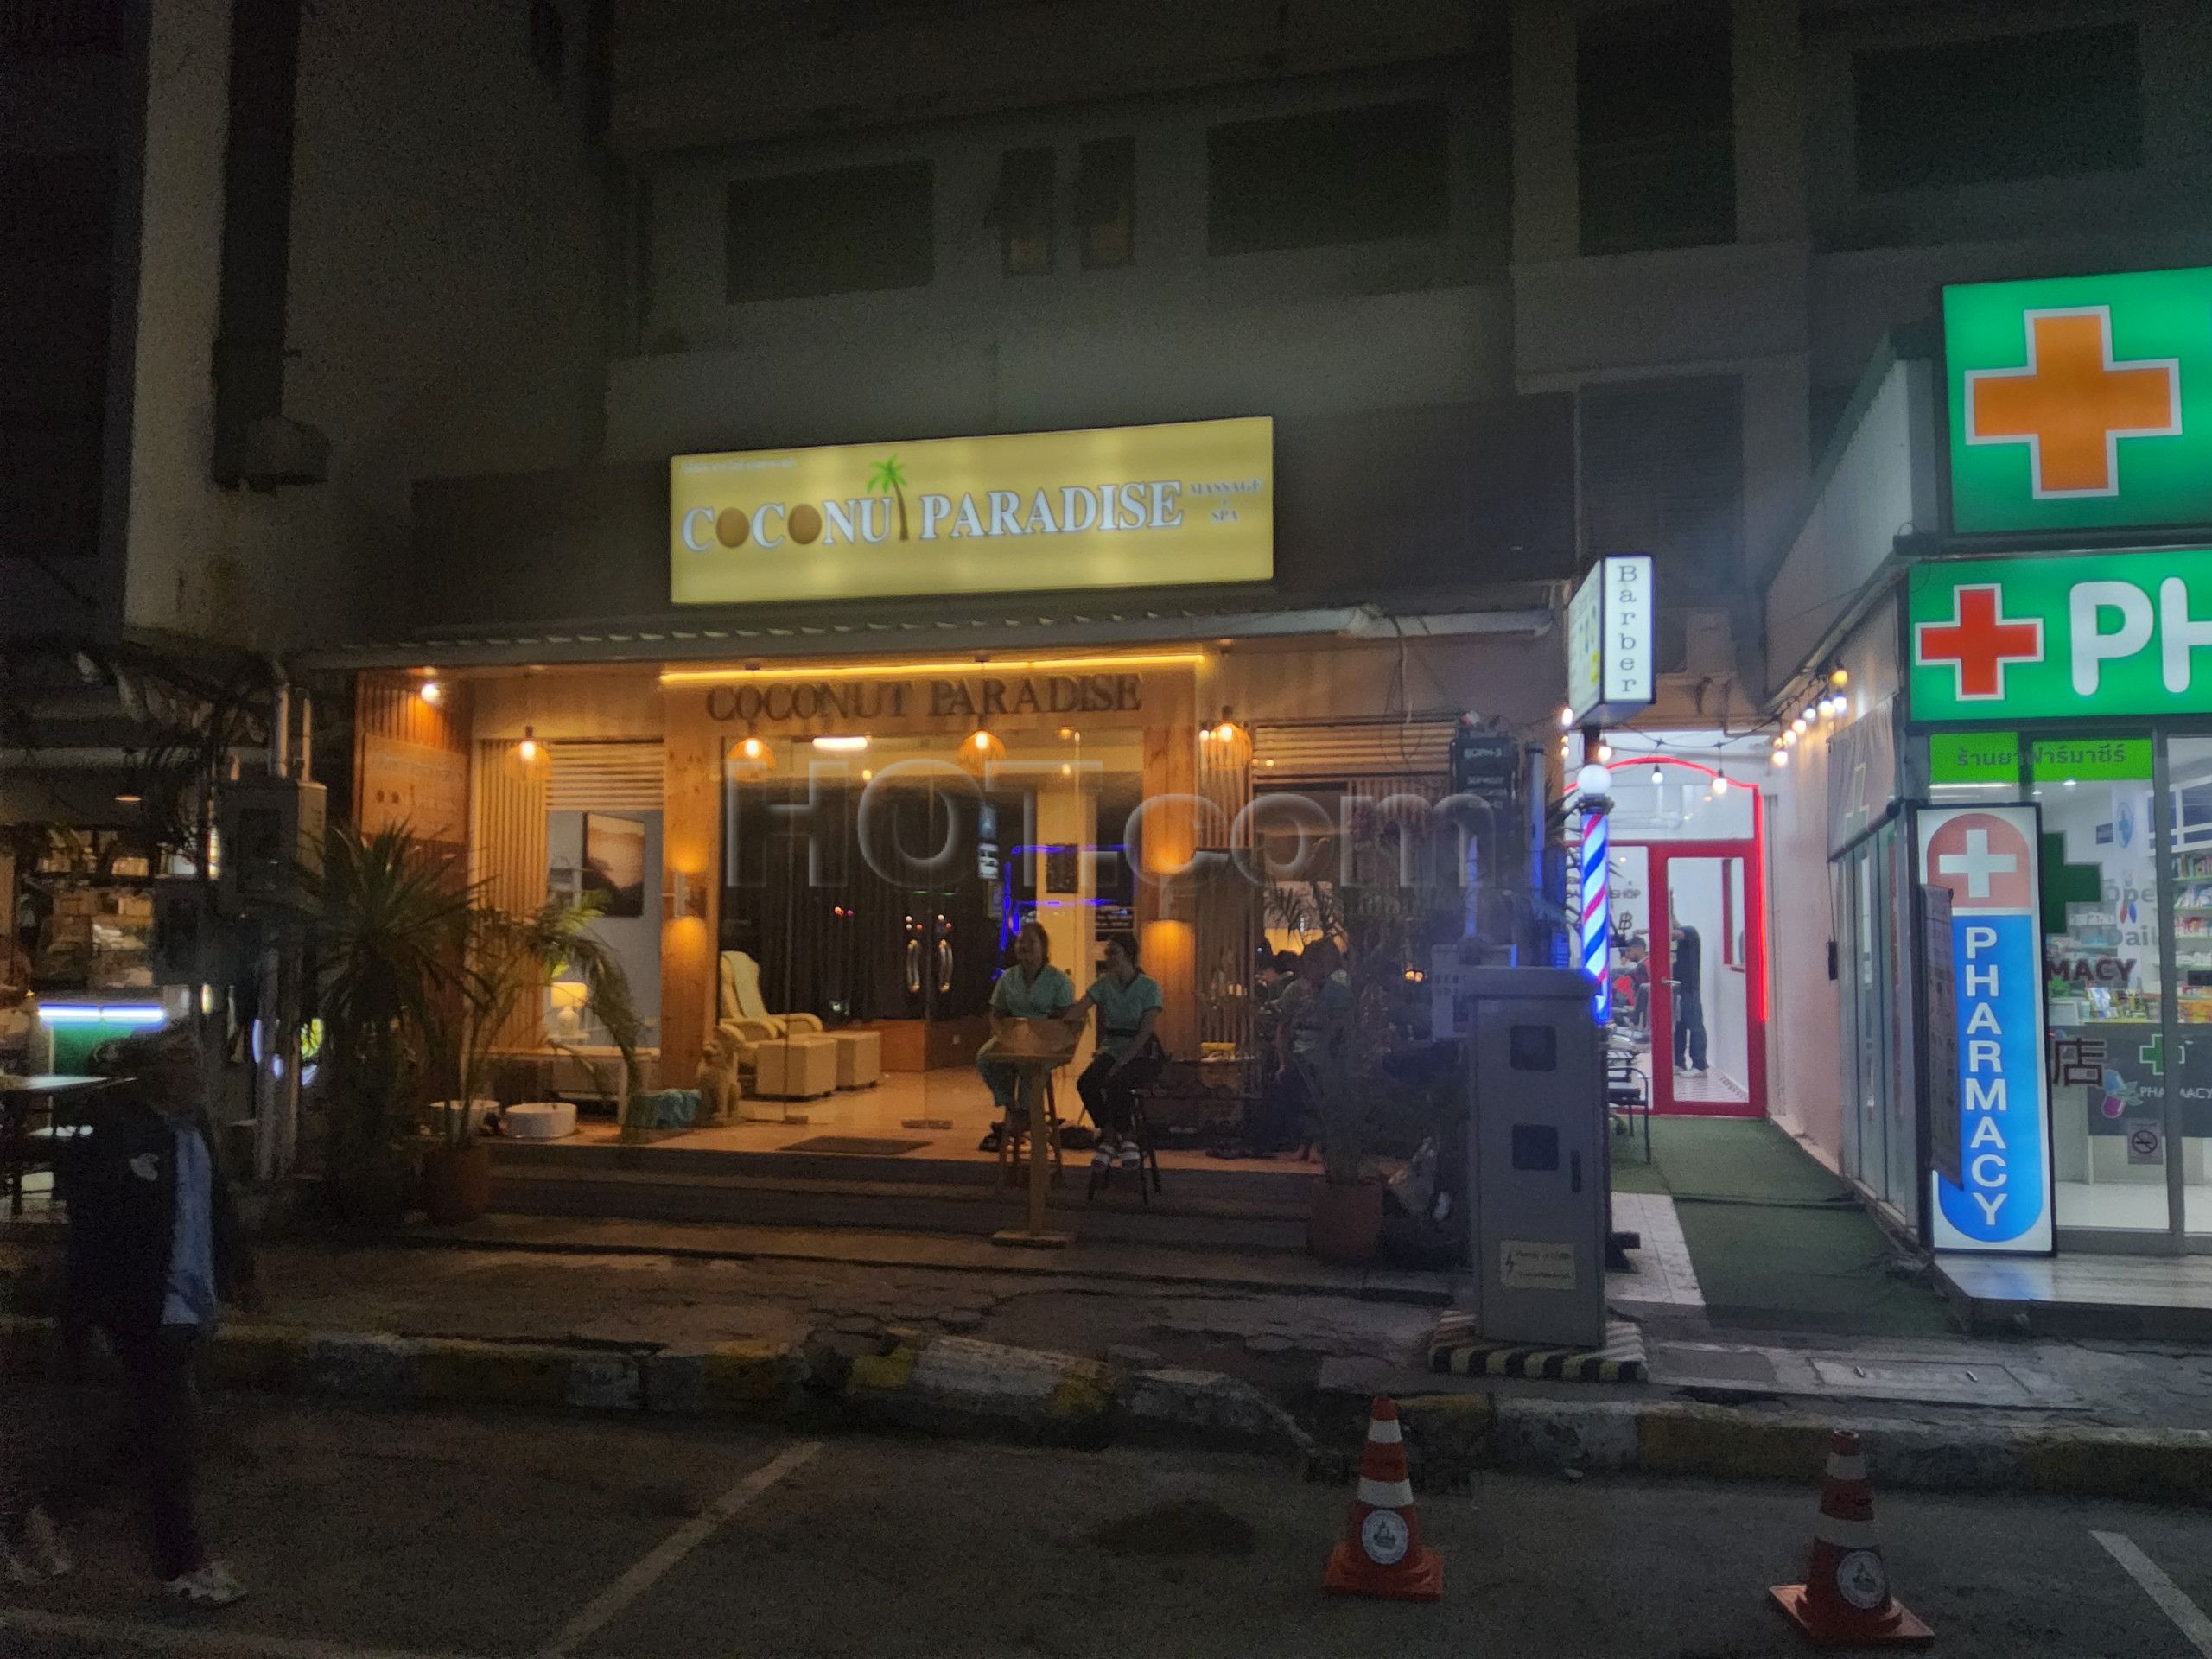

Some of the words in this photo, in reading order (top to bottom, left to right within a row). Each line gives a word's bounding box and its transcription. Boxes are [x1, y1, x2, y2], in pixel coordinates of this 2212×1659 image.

[919, 479, 1185, 541] PARADISE
[1618, 565, 1638, 692] Barber
[705, 681, 912, 723] COCONUT
[928, 672, 1143, 717] PARADISE
[1965, 927, 2008, 1226] PHARMACY
[2052, 1038, 2107, 1086] 店
